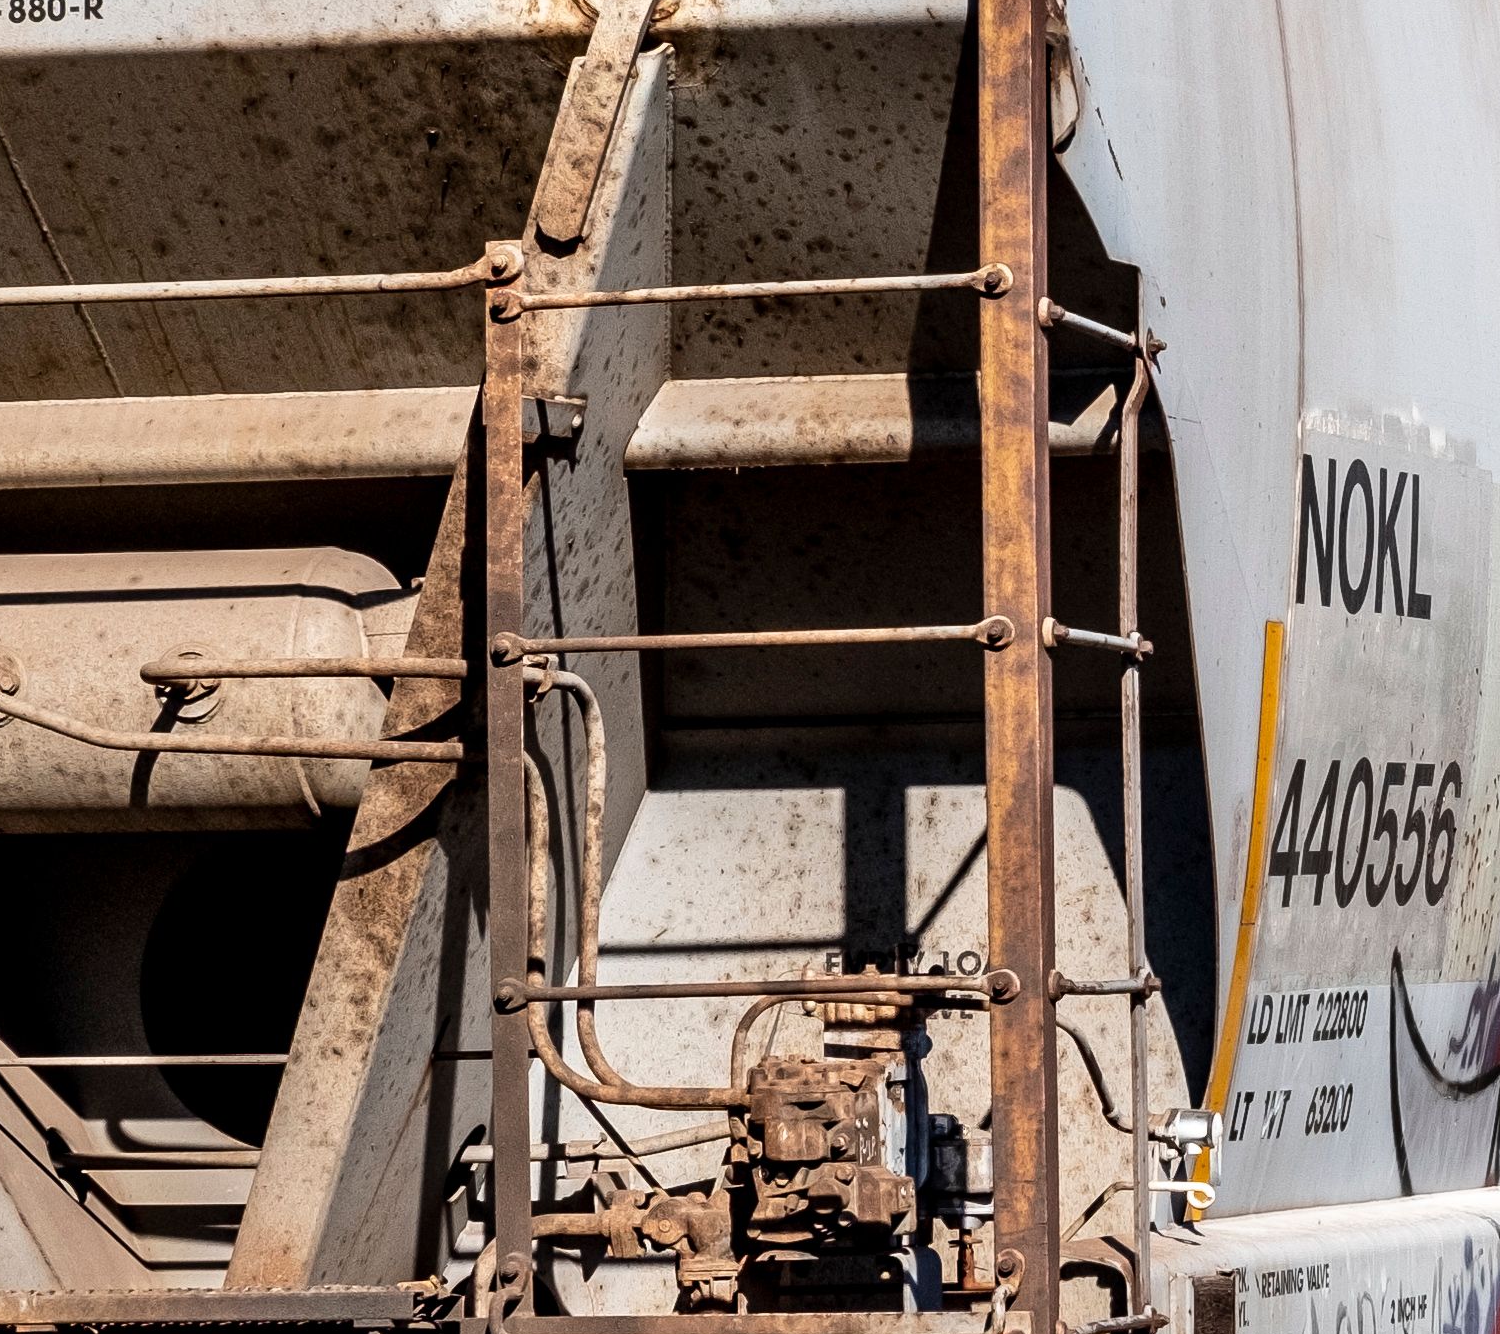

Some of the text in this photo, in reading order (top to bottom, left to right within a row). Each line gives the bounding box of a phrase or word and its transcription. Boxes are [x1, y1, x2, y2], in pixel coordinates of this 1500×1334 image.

[1295, 453, 1432, 620] NOKL
[1268, 757, 1463, 909] 440556
[943, 950, 990, 975] LO
[1247, 989, 1369, 1044] LD LMT 222800
[1229, 1082, 1354, 1142] LT WT 63200
[1261, 1264, 1330, 1298] RETAINING VALVE
[1390, 1300, 1396, 1325] 2
[1398, 1299, 1416, 1323] INCH
